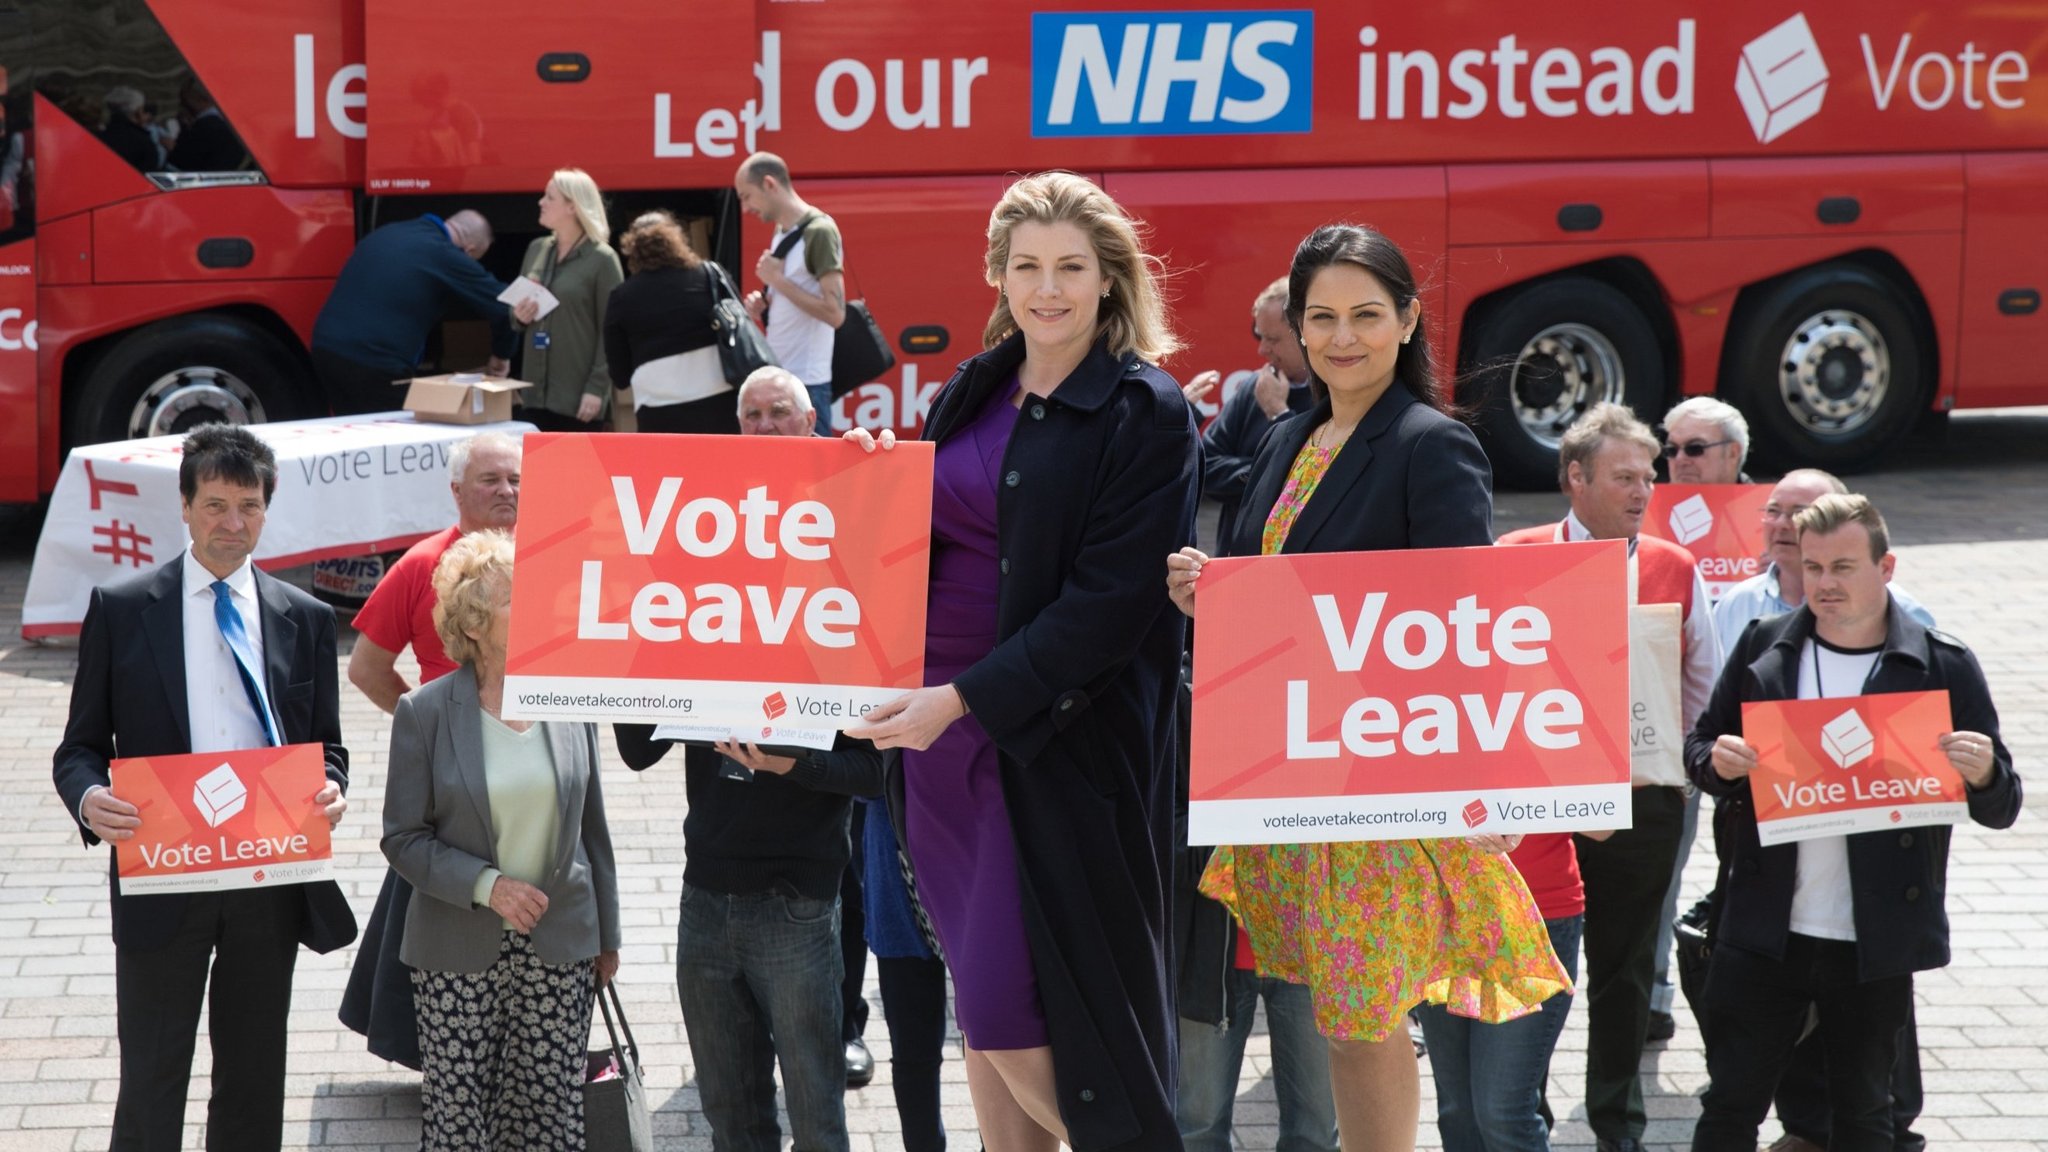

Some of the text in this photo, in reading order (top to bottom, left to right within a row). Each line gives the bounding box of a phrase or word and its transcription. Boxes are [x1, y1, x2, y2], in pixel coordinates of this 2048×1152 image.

[815, 57, 988, 132] our
[1047, 20, 1298, 125] NHS
[1358, 19, 1696, 121] instead
[1860, 33, 2029, 111] Vote
[299, 451, 371, 486] Vote
[611, 476, 836, 561] Vote
[577, 560, 860, 648] Leave
[1312, 592, 1552, 672] Vote
[518, 692, 693, 713] voteleavetakecontrol.org
[796, 696, 842, 717] Vote
[1287, 680, 1584, 760] Leave
[1497, 798, 1616, 821] Vote Leave
[1774, 776, 1942, 809] Vote Leave
[1263, 808, 1447, 829] voteleavetakecontrol.org
[139, 834, 309, 869] Vote Leave
[269, 866, 326, 879] Vote Leave
